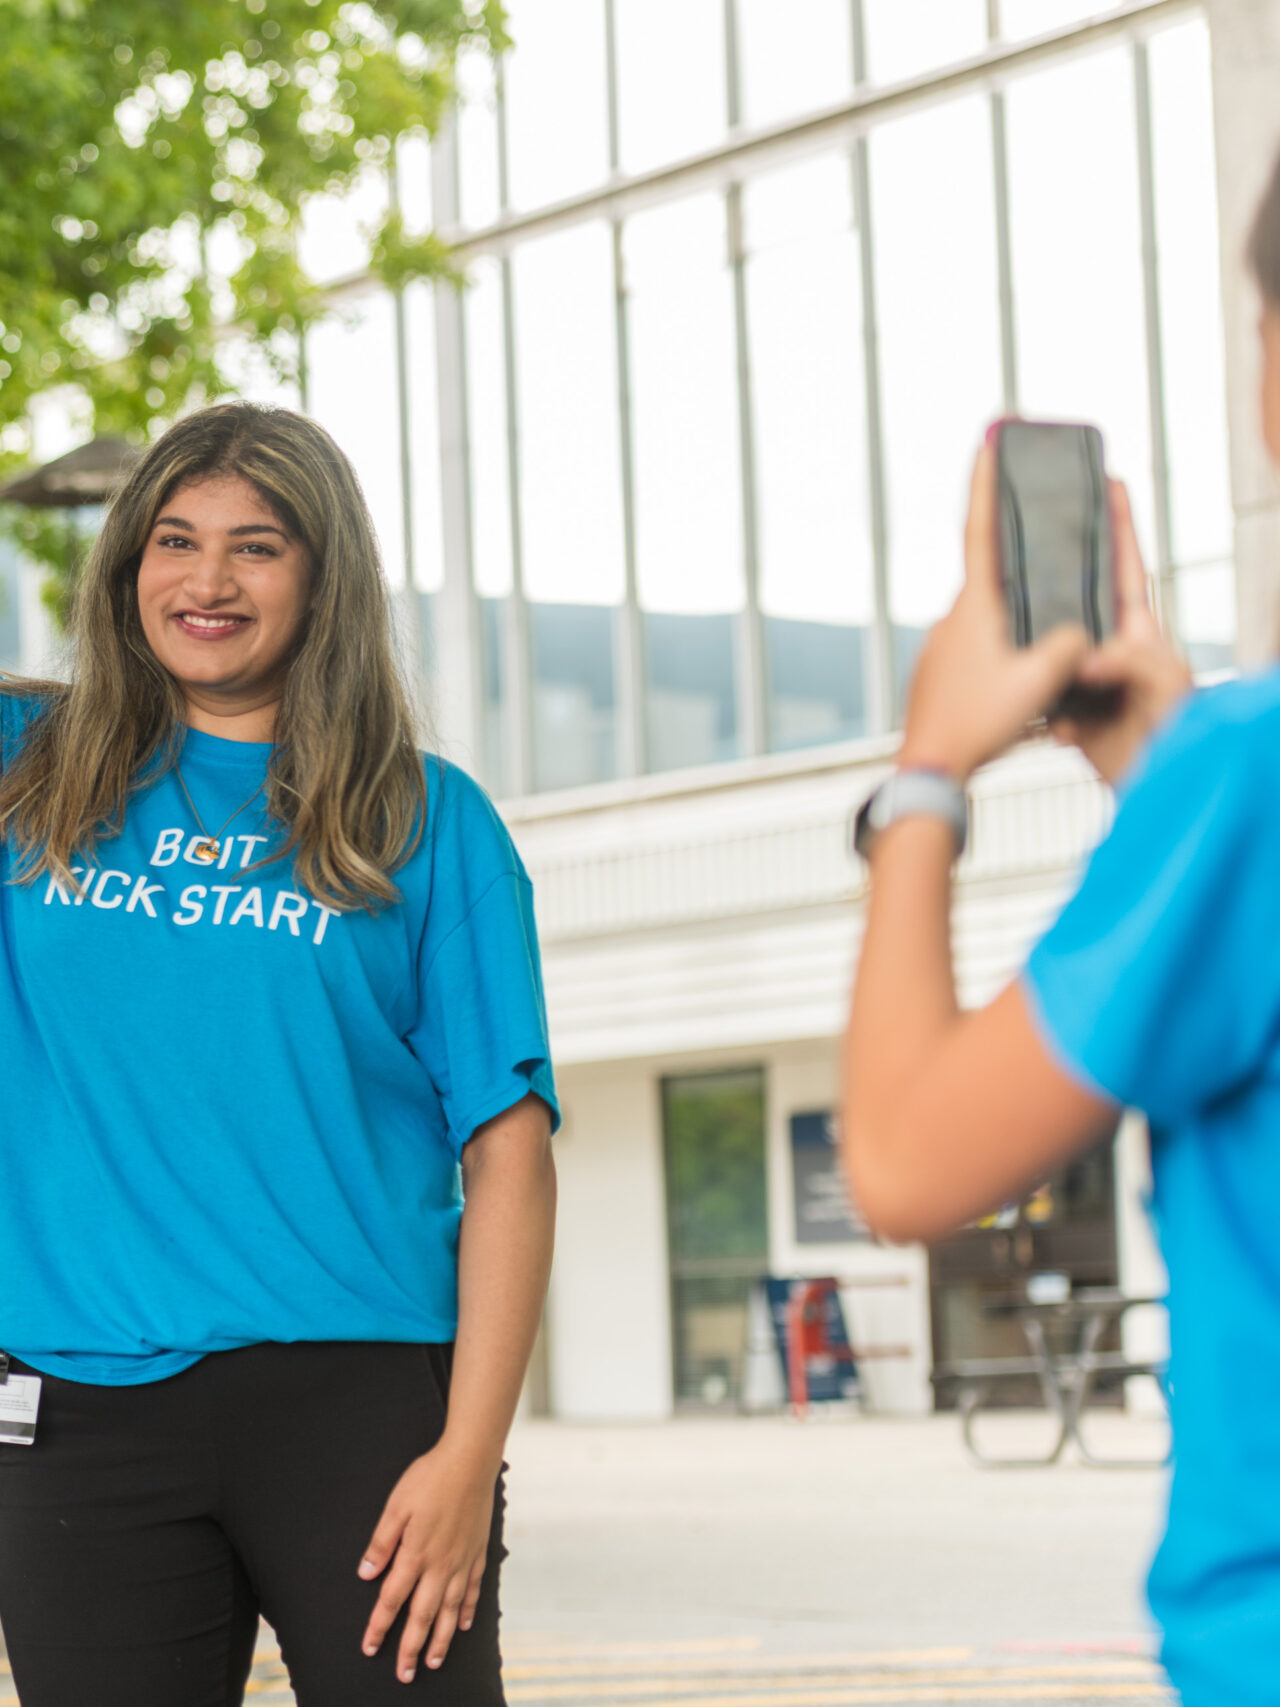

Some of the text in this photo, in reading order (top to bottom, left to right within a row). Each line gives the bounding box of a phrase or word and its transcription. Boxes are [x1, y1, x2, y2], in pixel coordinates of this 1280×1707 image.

[150, 828, 268, 869] BCIT
[44, 867, 342, 945] KICK START
